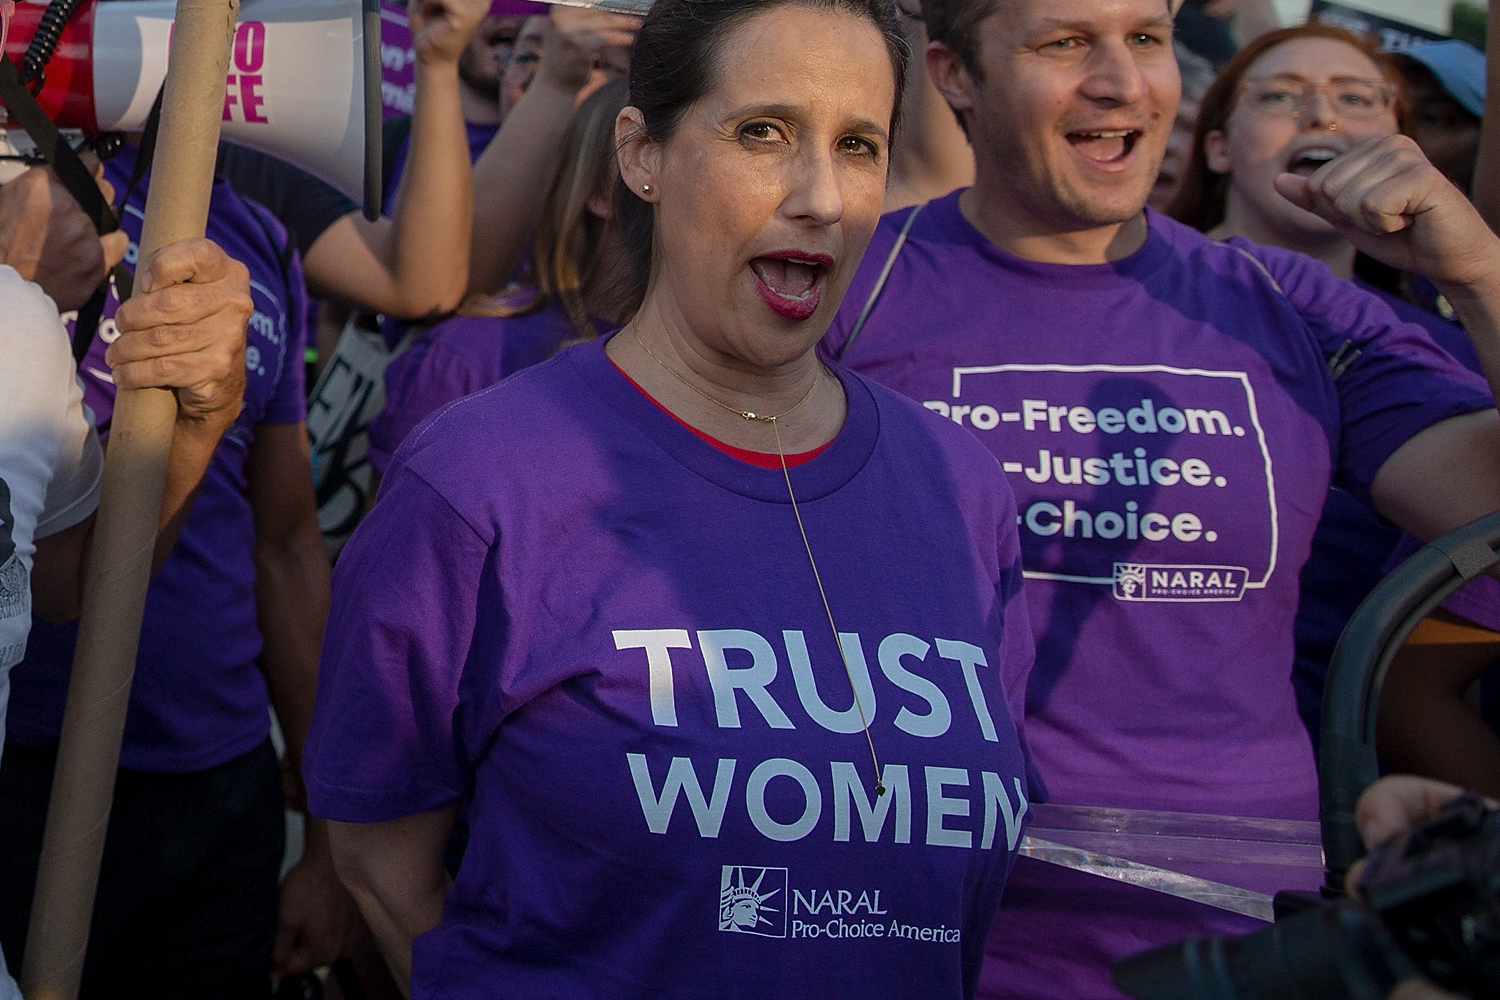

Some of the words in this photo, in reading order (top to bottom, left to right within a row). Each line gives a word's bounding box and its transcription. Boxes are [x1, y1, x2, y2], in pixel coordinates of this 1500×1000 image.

[1151, 571, 1238, 589] NARAL
[612, 628, 999, 743] TRUST
[626, 752, 1029, 852] WOMEN
[792, 889, 888, 915] NARAL
[791, 918, 885, 939] Pro-Choice
[887, 919, 962, 943] America
